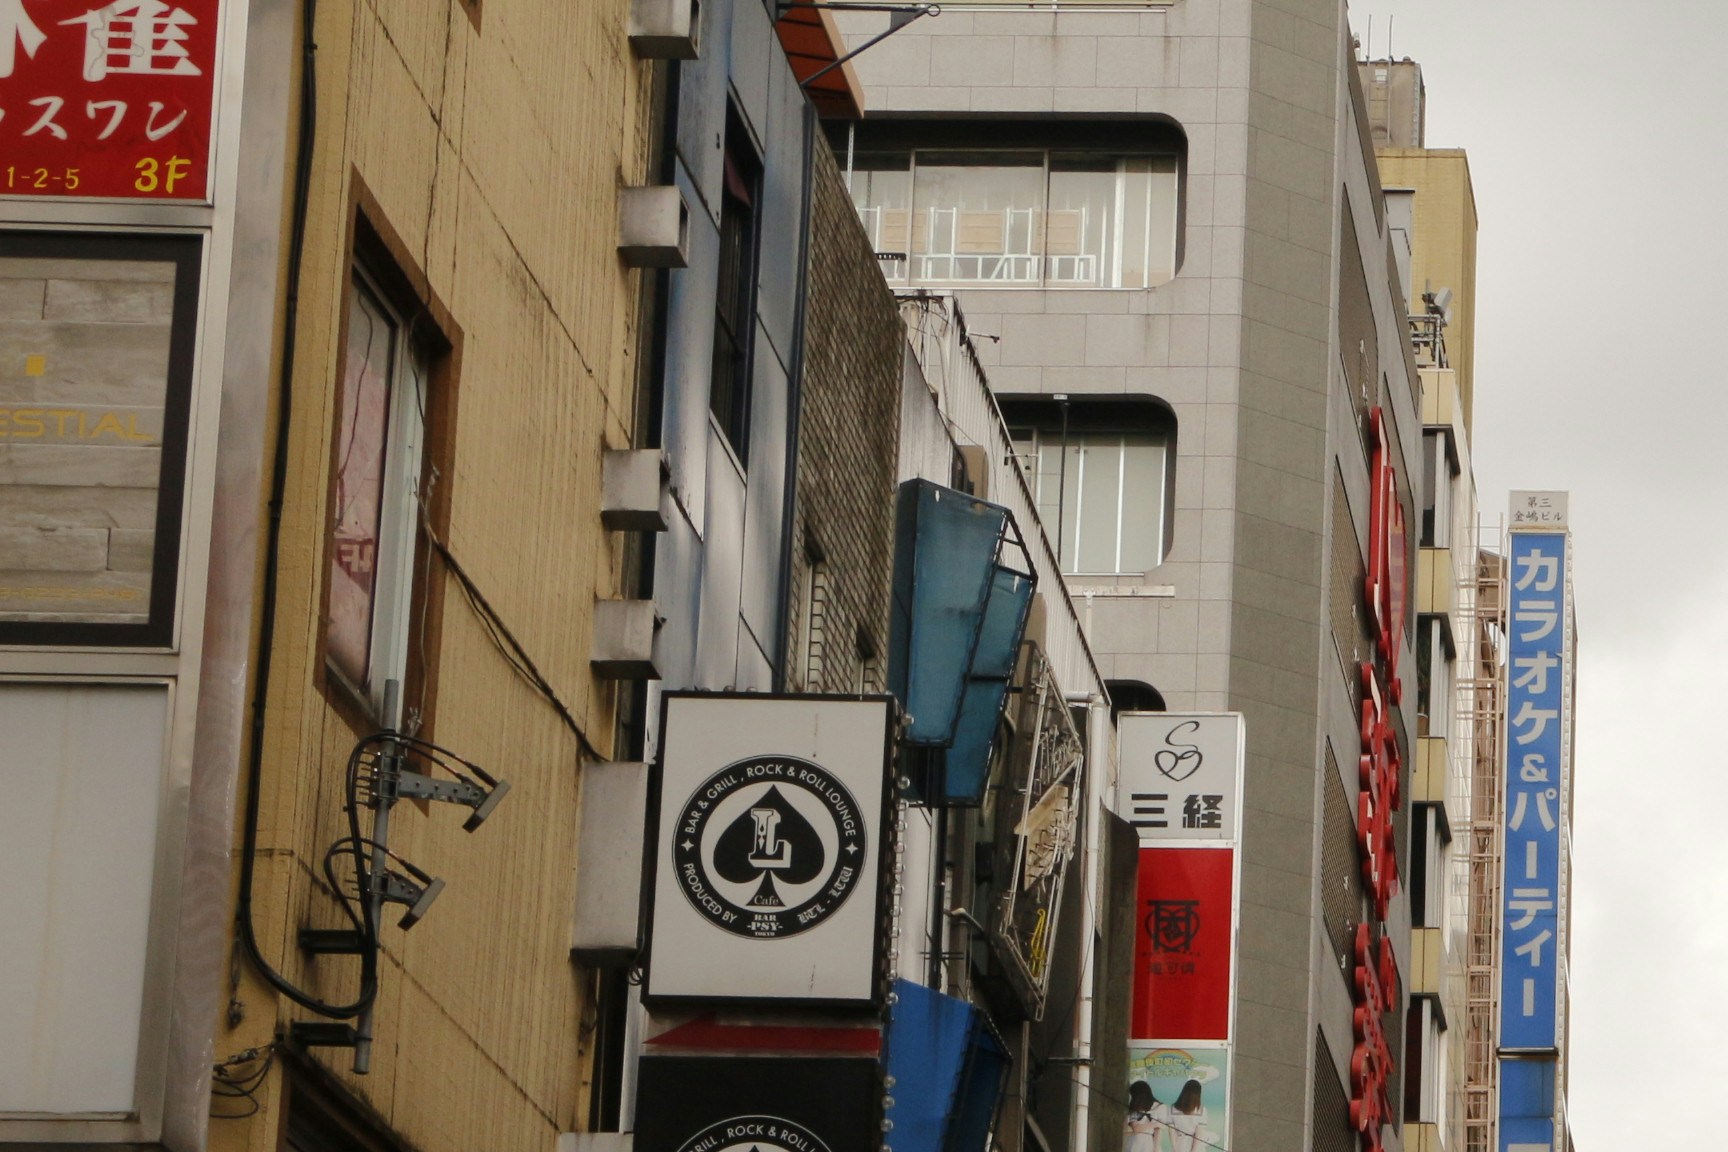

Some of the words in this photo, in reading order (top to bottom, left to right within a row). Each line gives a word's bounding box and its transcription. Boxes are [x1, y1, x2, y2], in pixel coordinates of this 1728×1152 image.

[0, 96, 187, 141] スワン
[135, 156, 191, 193] 3F
[1526, 497, 1552, 509] 第三
[687, 811, 702, 834] BAR
[698, 799, 710, 810] &
[746, 764, 783, 777] ROCK
[787, 766, 796, 777] &
[799, 769, 826, 791] ROLL
[826, 787, 857, 837] LOUNGE
[1508, 549, 1560, 1018] カラオケ&パーティー
[1129, 793, 1224, 829] 三経
[683, 863, 723, 916] PRODUCED
[722, 911, 738, 924] BY
[753, 914, 777, 922] BAR
[753, 894, 780, 906] Cafe
[727, 1124, 764, 1138] ROCK
[768, 1126, 777, 1137] &
[780, 1130, 806, 1152] ROLL
